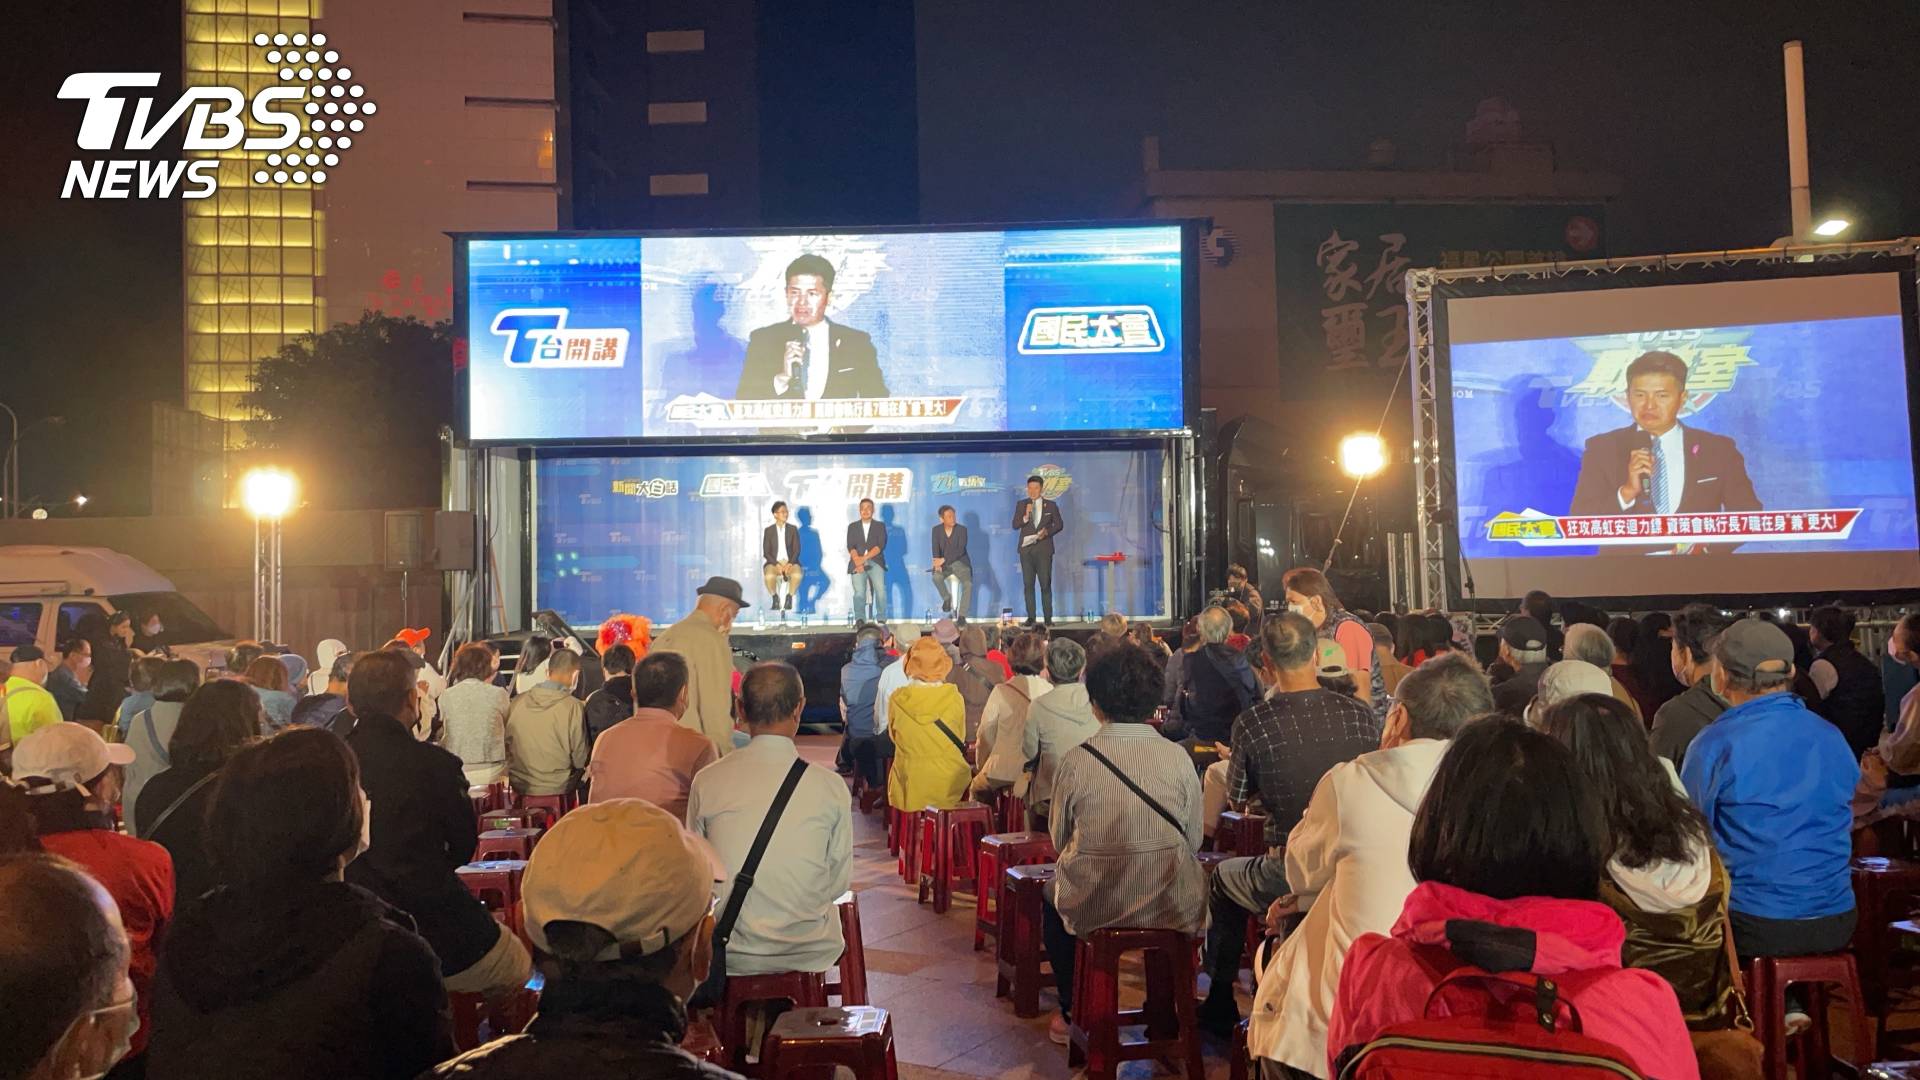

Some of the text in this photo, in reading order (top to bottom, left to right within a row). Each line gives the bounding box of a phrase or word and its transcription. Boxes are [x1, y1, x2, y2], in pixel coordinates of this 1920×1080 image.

[1030, 313, 1157, 347] 國民大會
[787, 470, 905, 500] T開講
